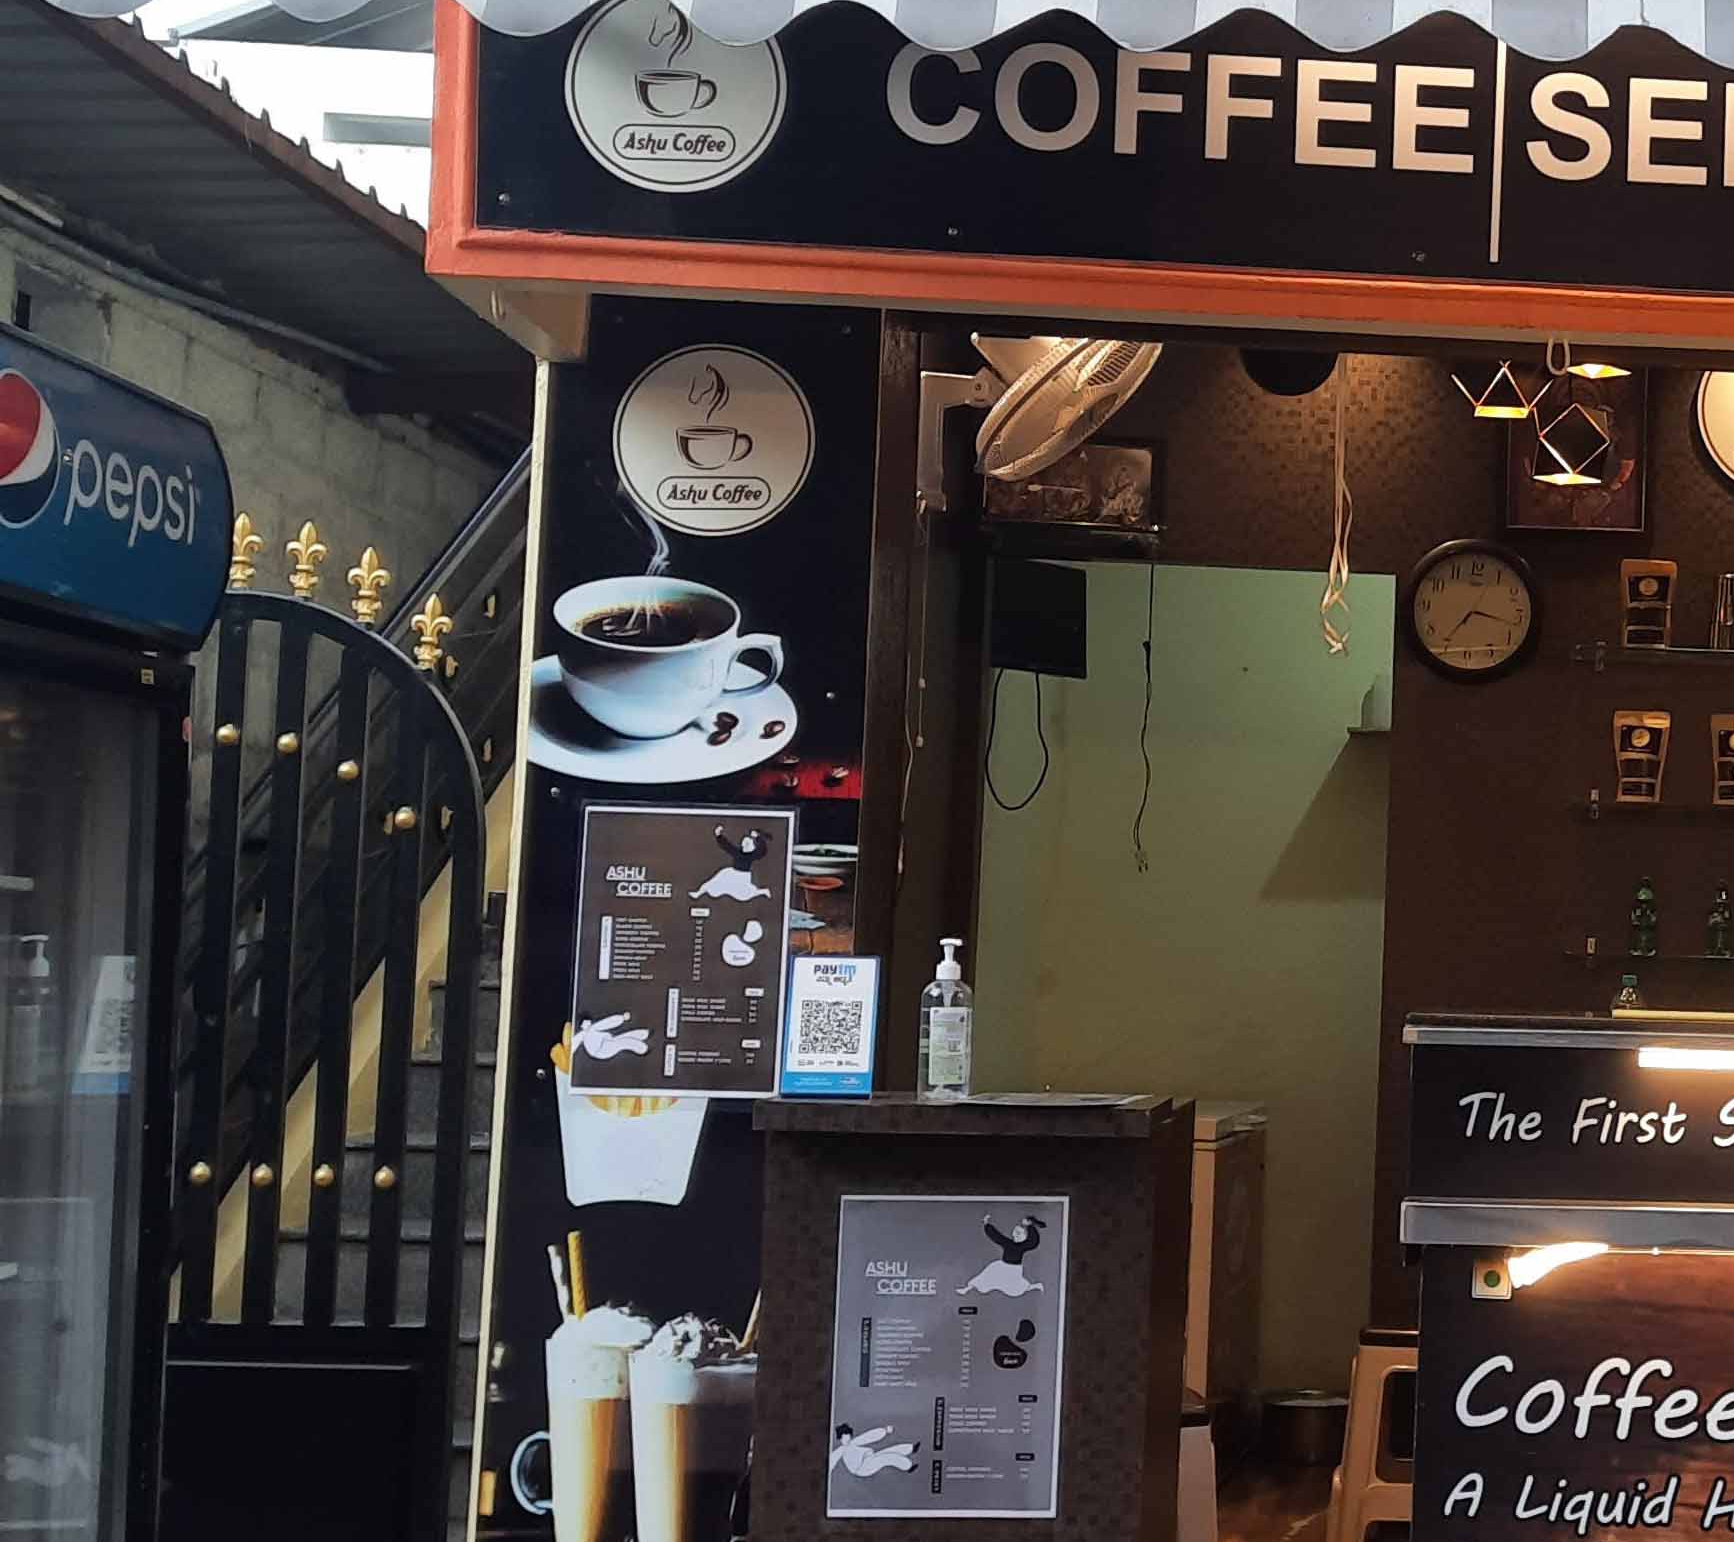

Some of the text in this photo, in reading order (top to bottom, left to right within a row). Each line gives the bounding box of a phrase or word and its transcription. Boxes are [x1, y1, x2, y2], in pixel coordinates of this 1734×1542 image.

[885, 41, 1476, 175] COFFEE
[623, 131, 727, 155] Ashu Coffee
[63, 439, 196, 548] pepsi
[665, 482, 763, 506] Ashu Coffee
[606, 865, 646, 880] ASHU
[616, 882, 672, 895] COFFEE
[1458, 1091, 1543, 1143] The
[1571, 1096, 1687, 1146] First
[865, 1261, 909, 1276] ASHU
[876, 1279, 937, 1293] COFFEE
[1443, 1471, 1485, 1518] A
[1515, 1474, 1681, 1535] Liquid
